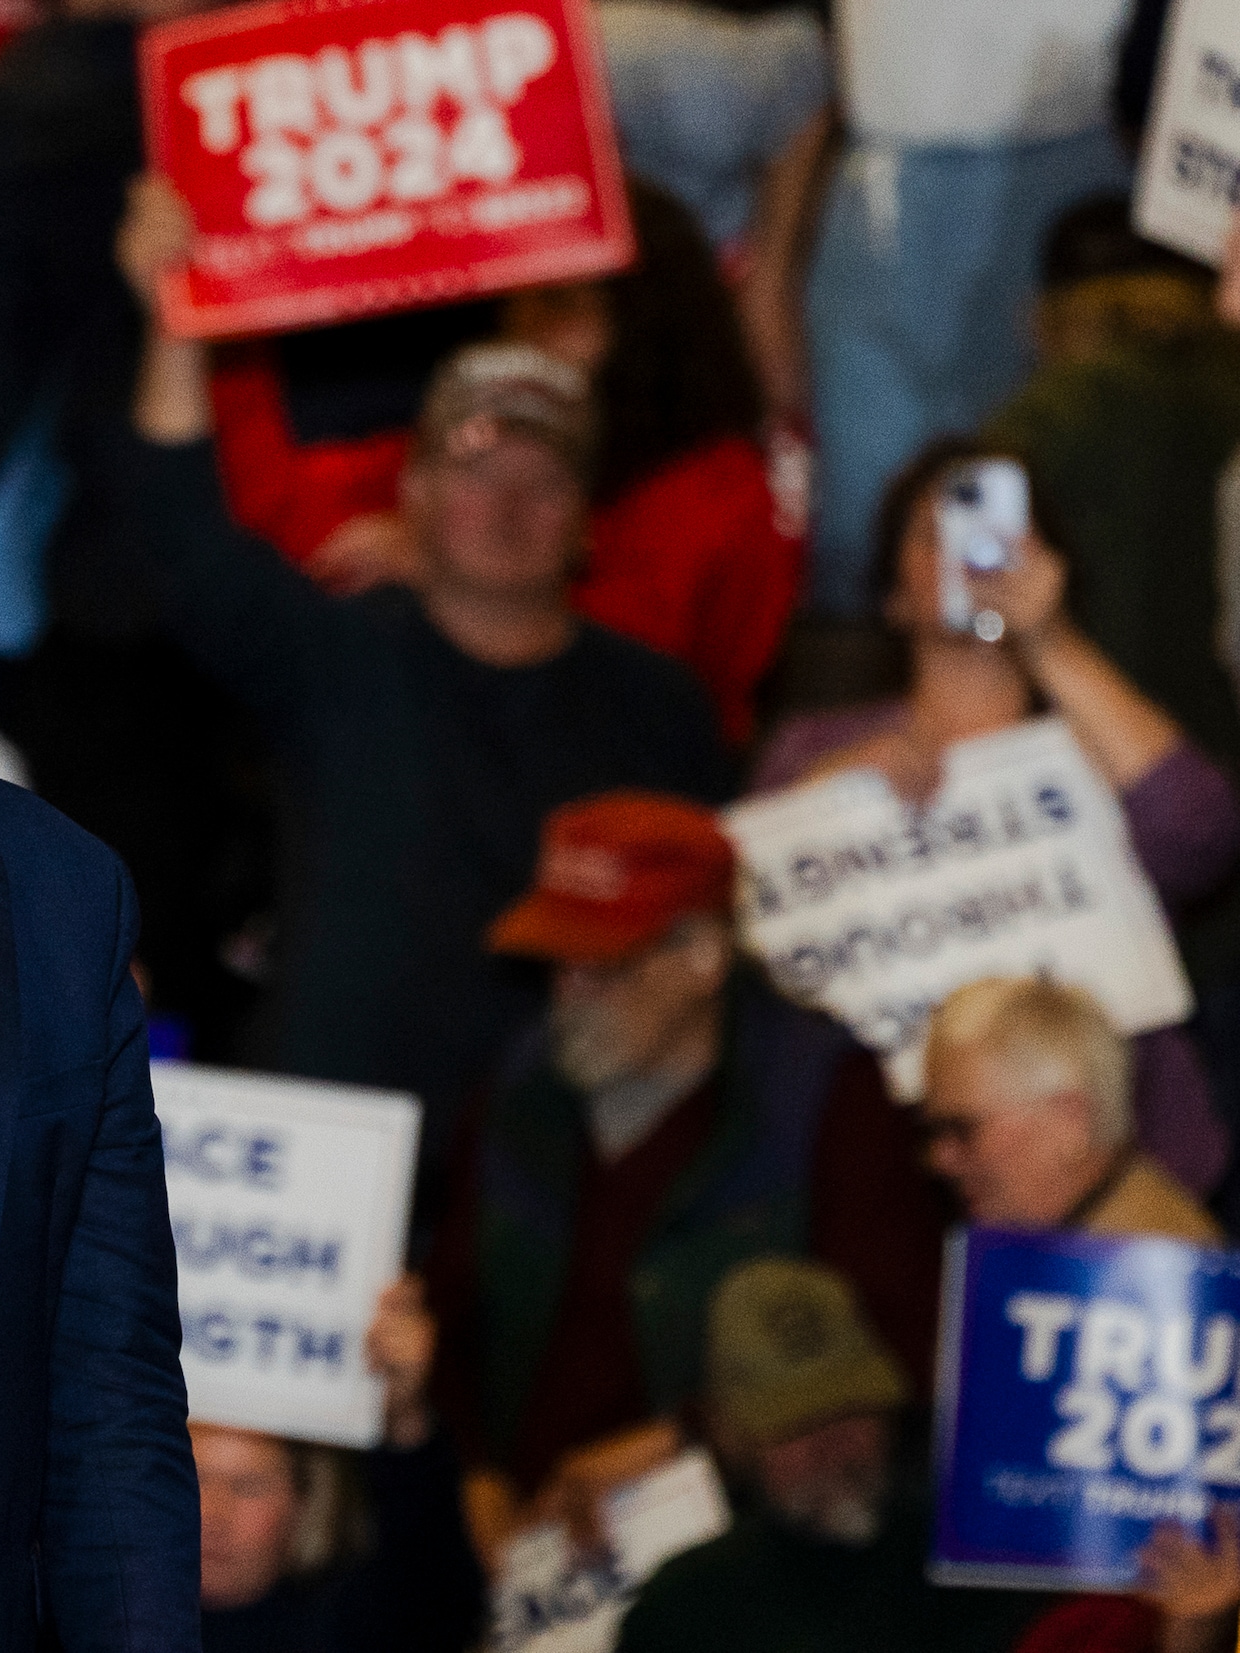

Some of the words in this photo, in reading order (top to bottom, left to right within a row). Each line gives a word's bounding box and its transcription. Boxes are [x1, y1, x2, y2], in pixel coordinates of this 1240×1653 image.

[182, 13, 555, 153] TRUMP
[240, 103, 522, 226] 2024
[754, 778, 1076, 914] STRENGT
[774, 860, 1086, 990] THROUG
[162, 1122, 285, 1190] ACE
[174, 1218, 342, 1286] UGH
[182, 1305, 345, 1376] GTH
[1006, 1290, 1240, 1397] TRU
[1046, 1384, 1240, 1486] 202
